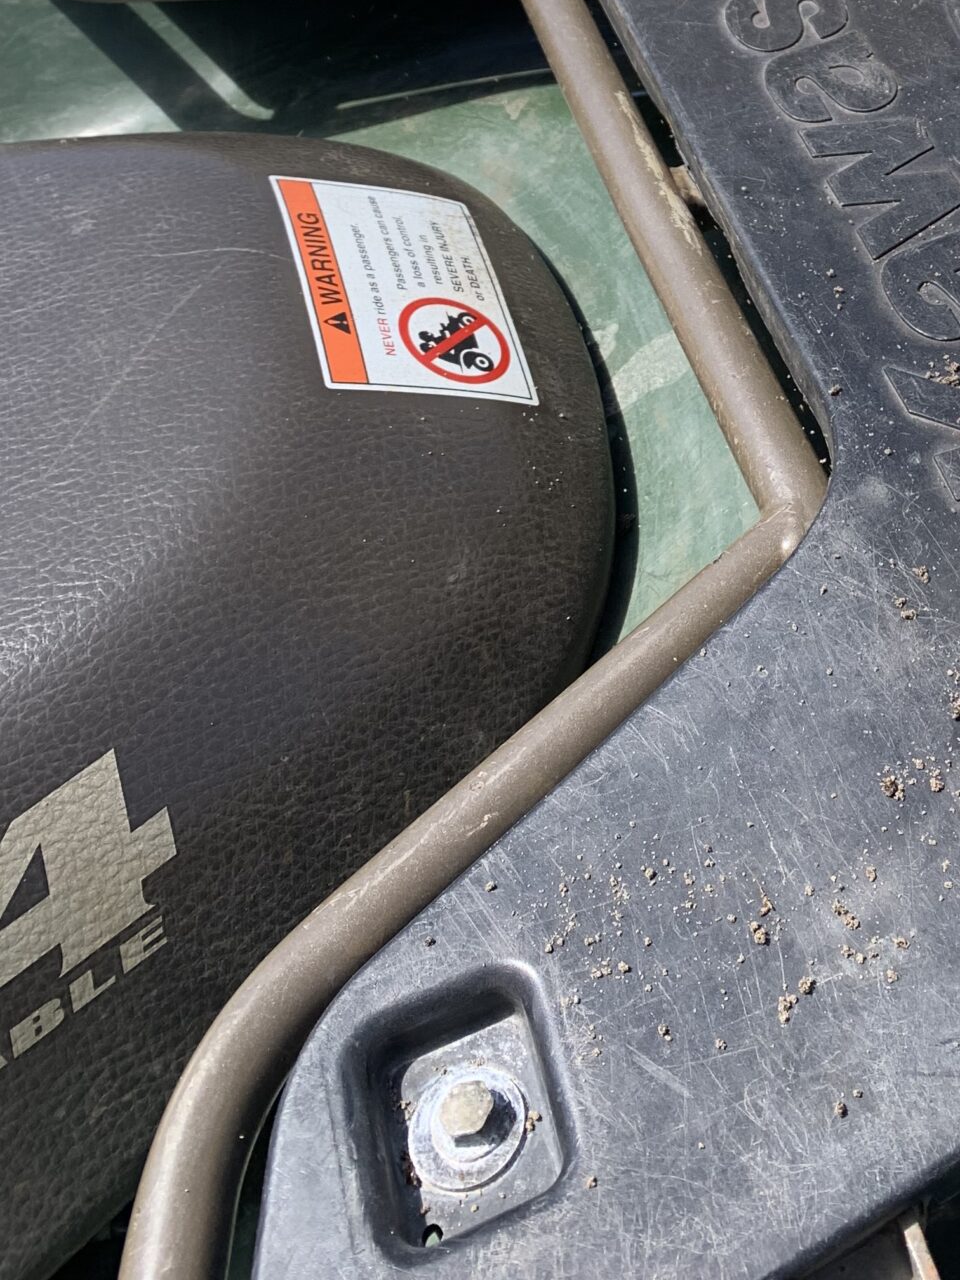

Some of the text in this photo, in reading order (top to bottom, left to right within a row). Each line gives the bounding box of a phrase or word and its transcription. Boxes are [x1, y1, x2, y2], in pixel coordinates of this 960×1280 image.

[297, 211, 344, 306] WARNING
[350, 223, 376, 271] passenger.
[368, 196, 408, 290] Passengers can cause
[407, 248, 416, 258] of
[418, 235, 444, 285] resulting in
[430, 221, 464, 293] SEVERE INJURY
[368, 282, 381, 296] as
[410, 263, 422, 279] loss
[372, 296, 387, 315] ride
[475, 292, 485, 302] or
[377, 318, 397, 356] NEVER
[0, 915, 168, 1070] BLE
